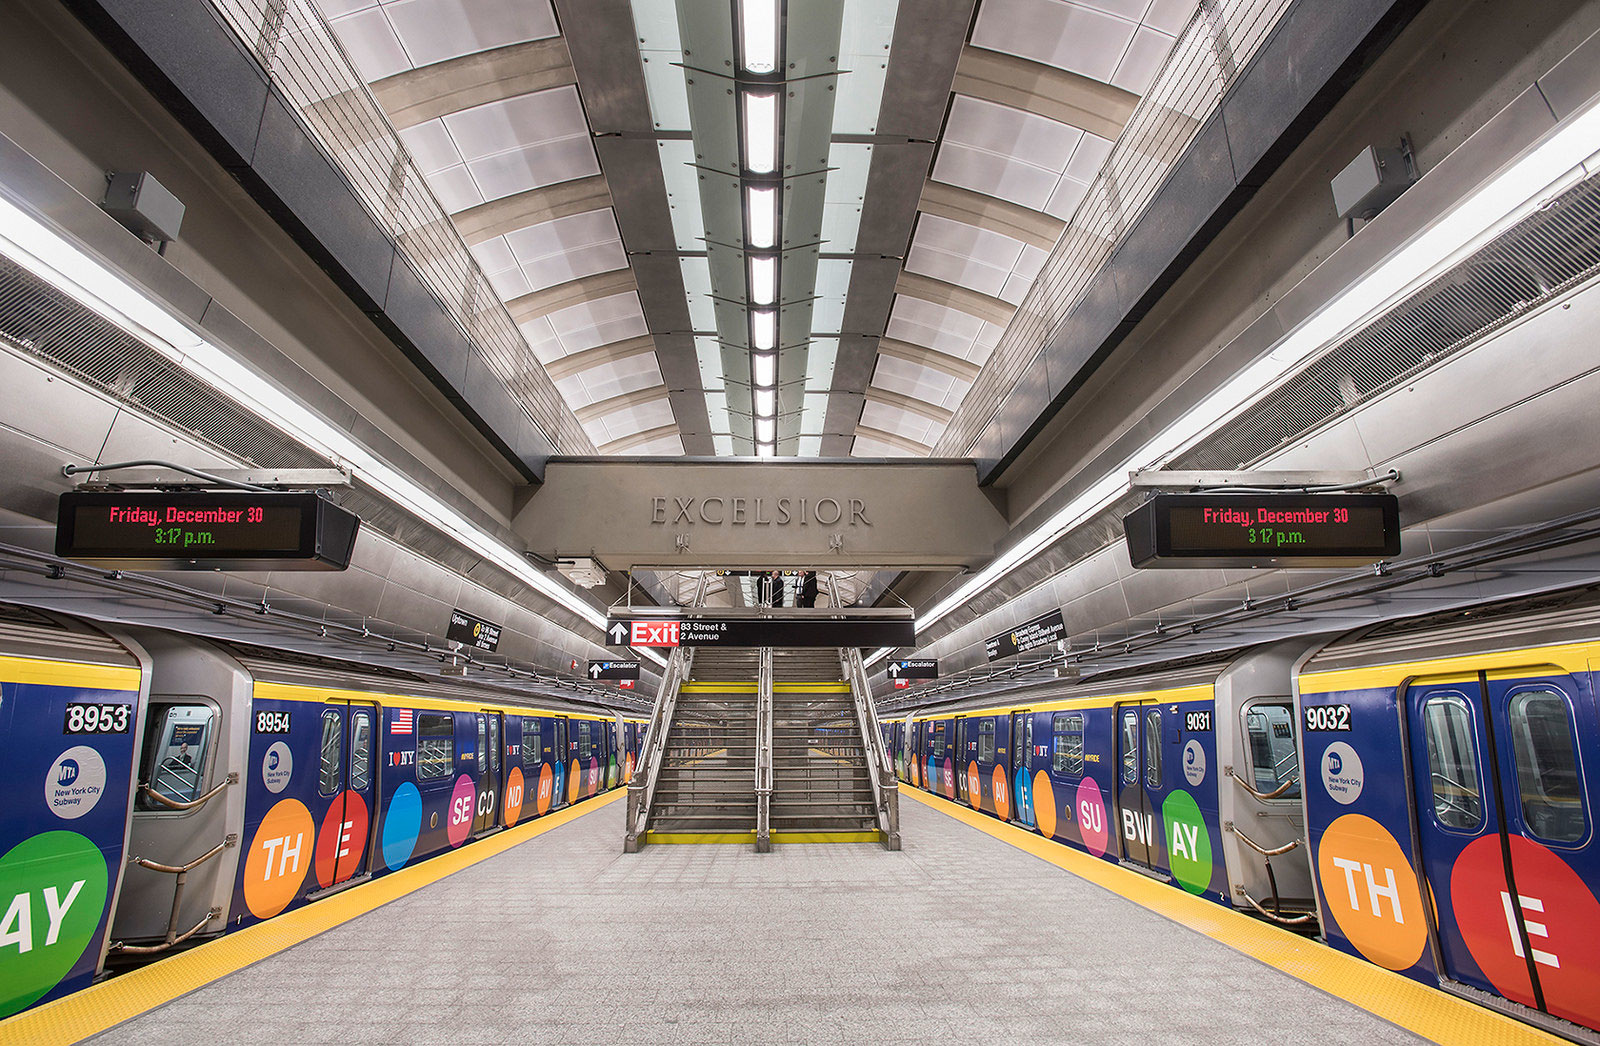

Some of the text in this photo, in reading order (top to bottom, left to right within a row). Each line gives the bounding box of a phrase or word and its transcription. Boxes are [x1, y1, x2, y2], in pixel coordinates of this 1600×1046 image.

[109, 507, 263, 526] Friday, December 30
[650, 496, 873, 526] EXCELSIOR
[1203, 508, 1348, 527] Friday, December 30
[155, 528, 216, 547] 3:17 p.m.
[1276, 530, 1306, 547] p.m.
[631, 622, 679, 643] Exit
[680, 622, 727, 631] 83 Street &
[680, 632, 719, 640] 2 Avenue
[68, 705, 128, 732] 8953
[257, 712, 290, 732] 8954
[1186, 711, 1210, 731] 9031
[1306, 706, 1350, 730] 9032
[400, 751, 415, 765] NY
[59, 765, 76, 781] MTA
[1328, 776, 1361, 788] New York City
[54, 785, 101, 798] New York City
[1328, 783, 1348, 793] Subway
[54, 797, 82, 807] Subway
[959, 773, 968, 791] CO
[995, 781, 1005, 803] AV
[1021, 785, 1029, 809] E
[1081, 800, 1102, 832] SU
[1122, 808, 1153, 847] BW
[1172, 821, 1199, 863] AY
[262, 832, 304, 881] TH
[334, 820, 354, 860] E
[453, 796, 471, 825] SE
[477, 790, 494, 816] CO
[508, 785, 522, 809] ND
[540, 779, 550, 799] AV
[1219, 892, 1225, 901] 2
[0, 879, 86, 954] AY
[237, 914, 242, 925] 1
[1333, 856, 1561, 970] TH E
